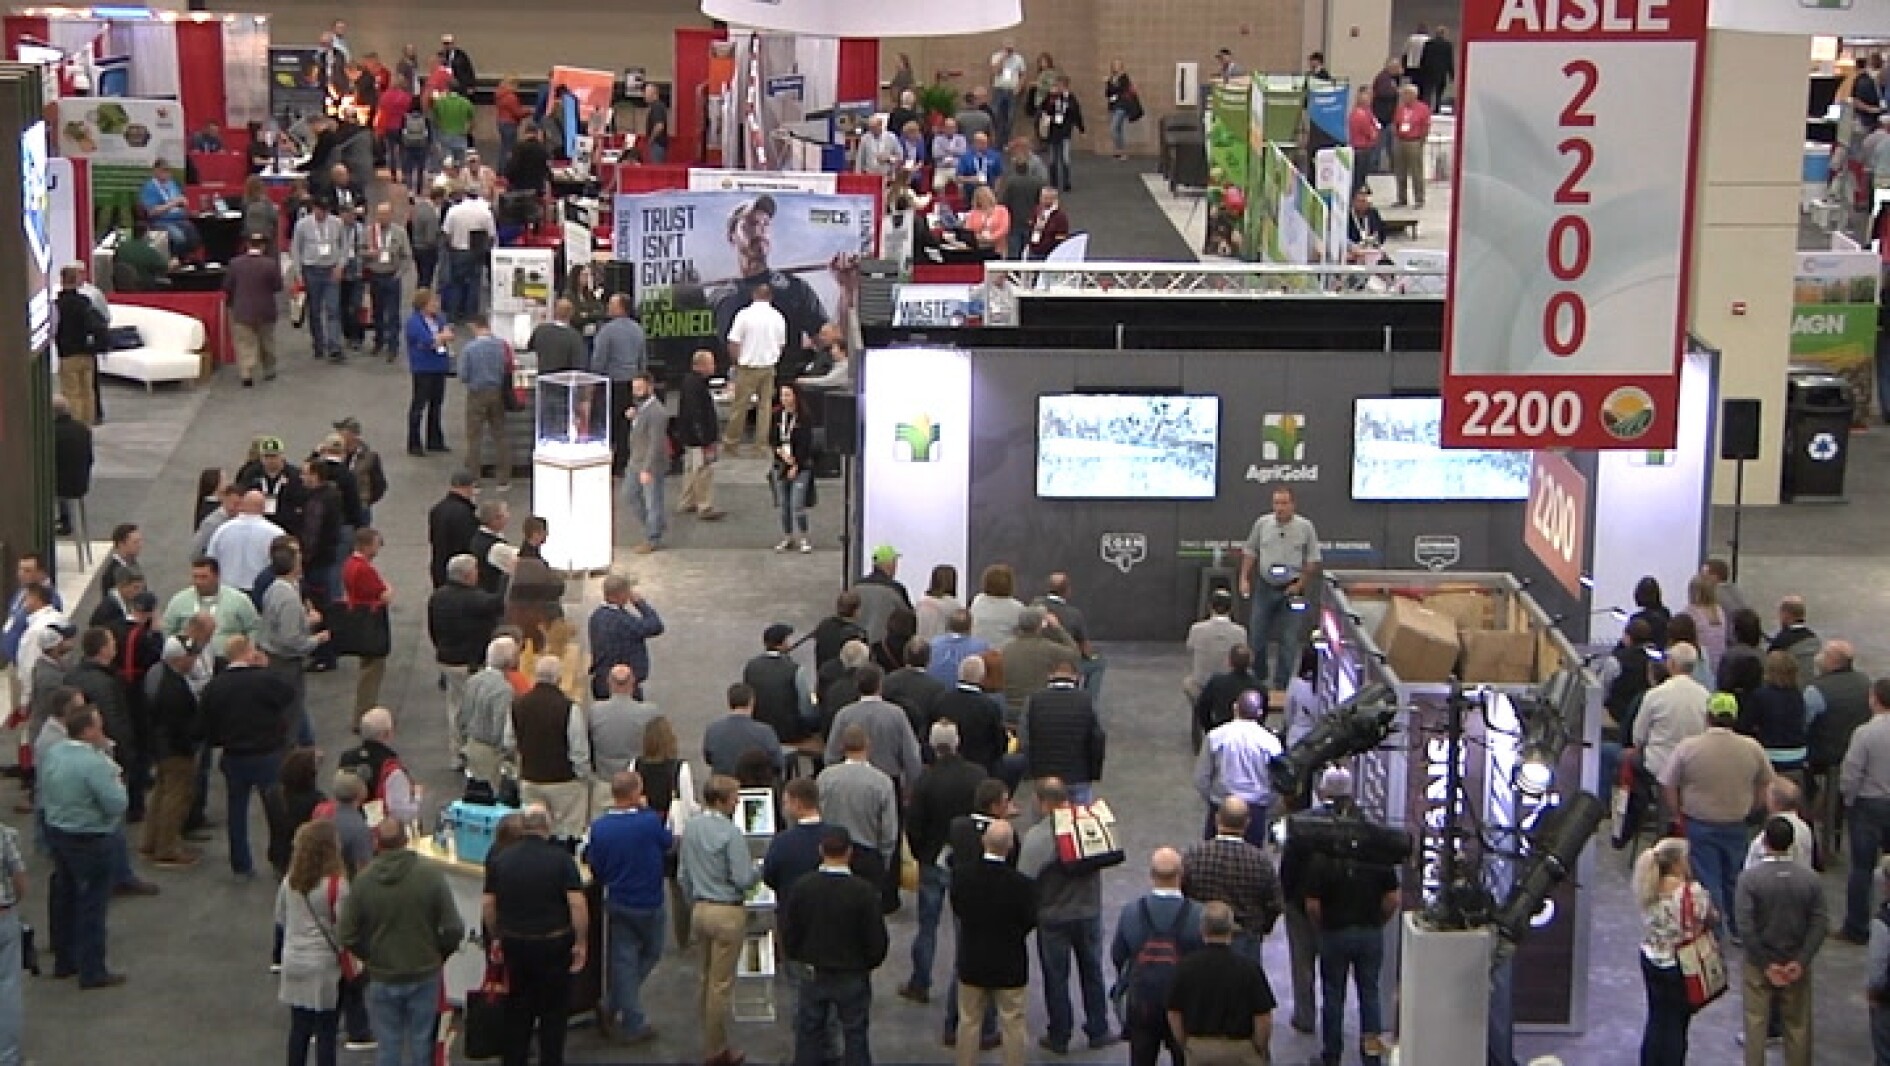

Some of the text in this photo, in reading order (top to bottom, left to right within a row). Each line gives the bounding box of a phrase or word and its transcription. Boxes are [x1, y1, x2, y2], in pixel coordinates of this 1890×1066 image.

[1495, 0, 1670, 32] AISLE
[641, 205, 697, 231] TRUST
[642, 232, 685, 257] ISN'T
[900, 300, 950, 319] WASTE
[1461, 389, 1584, 437] 2200
[1245, 464, 1319, 484] AgriGold
[1533, 464, 1576, 563] 2200
